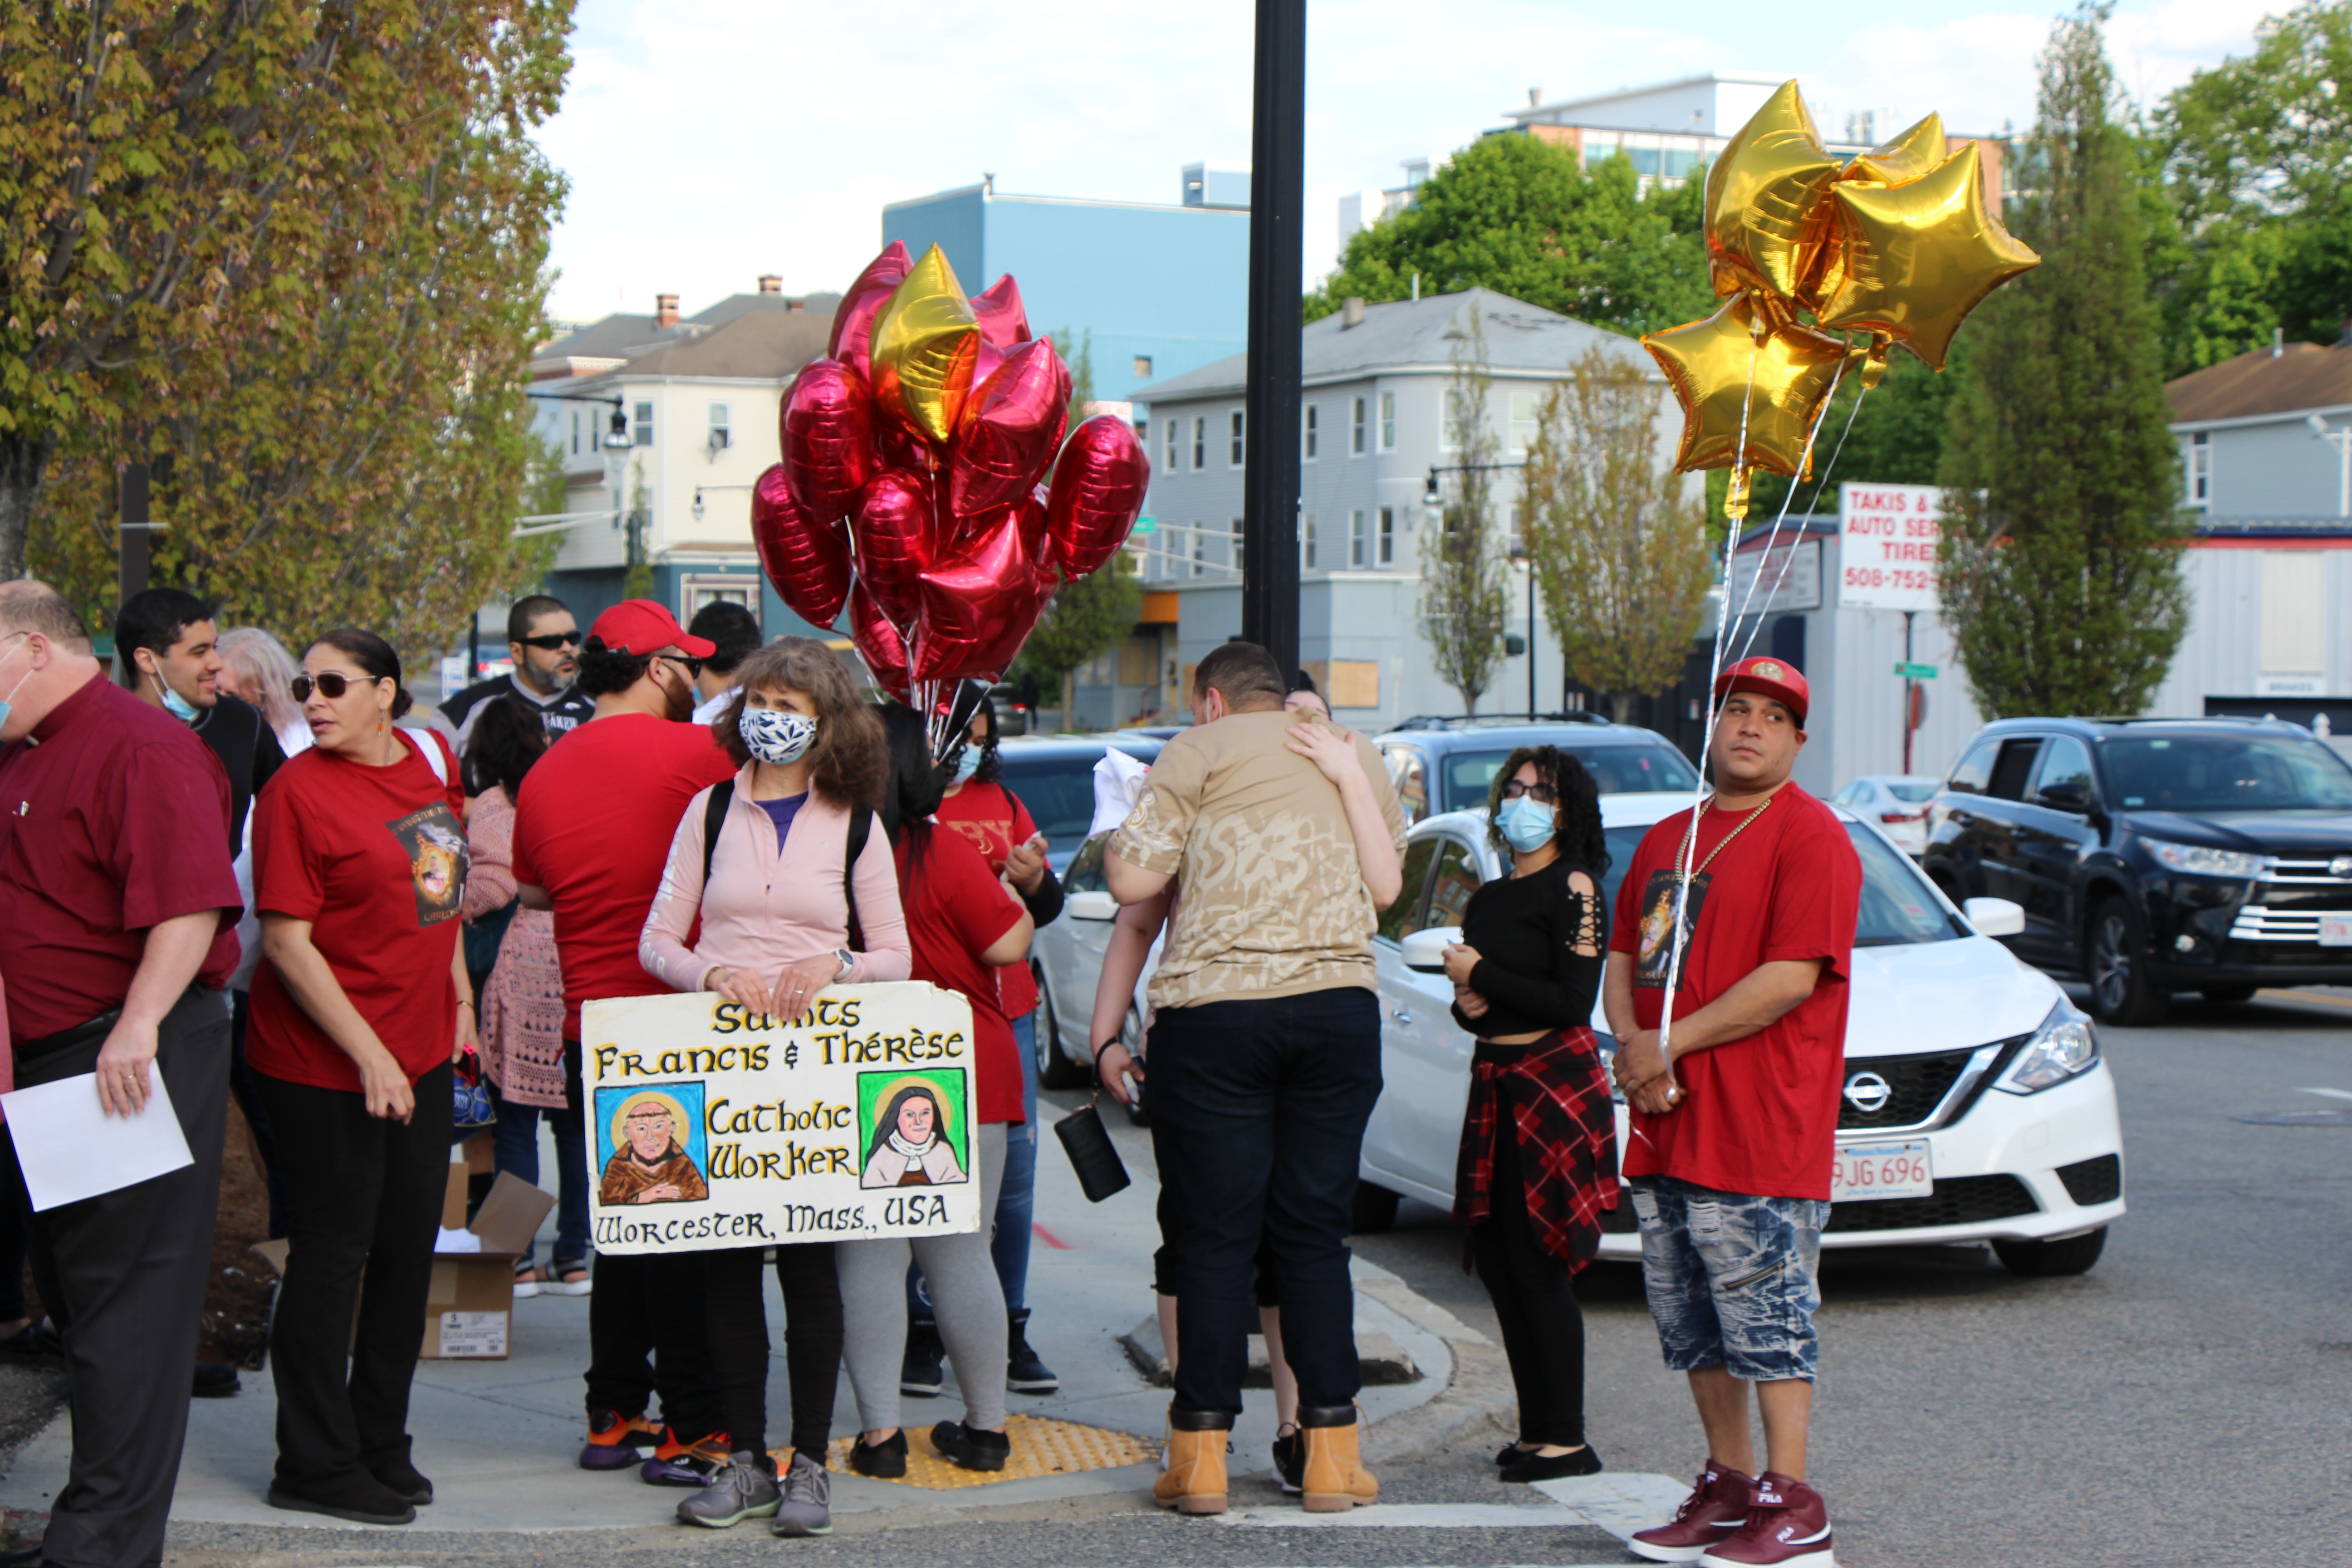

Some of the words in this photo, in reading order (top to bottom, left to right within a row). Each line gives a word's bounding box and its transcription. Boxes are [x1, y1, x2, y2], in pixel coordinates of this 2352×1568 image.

[1850, 491, 1907, 512] TAKIS
[1848, 517, 1896, 535] AUTO
[711, 998, 861, 1034] Sants
[706, 1098, 852, 1135] Catholic
[1881, 1156, 1925, 1184] 696
[884, 1195, 950, 1227] USA
[1758, 1492, 1783, 1504] FILA
